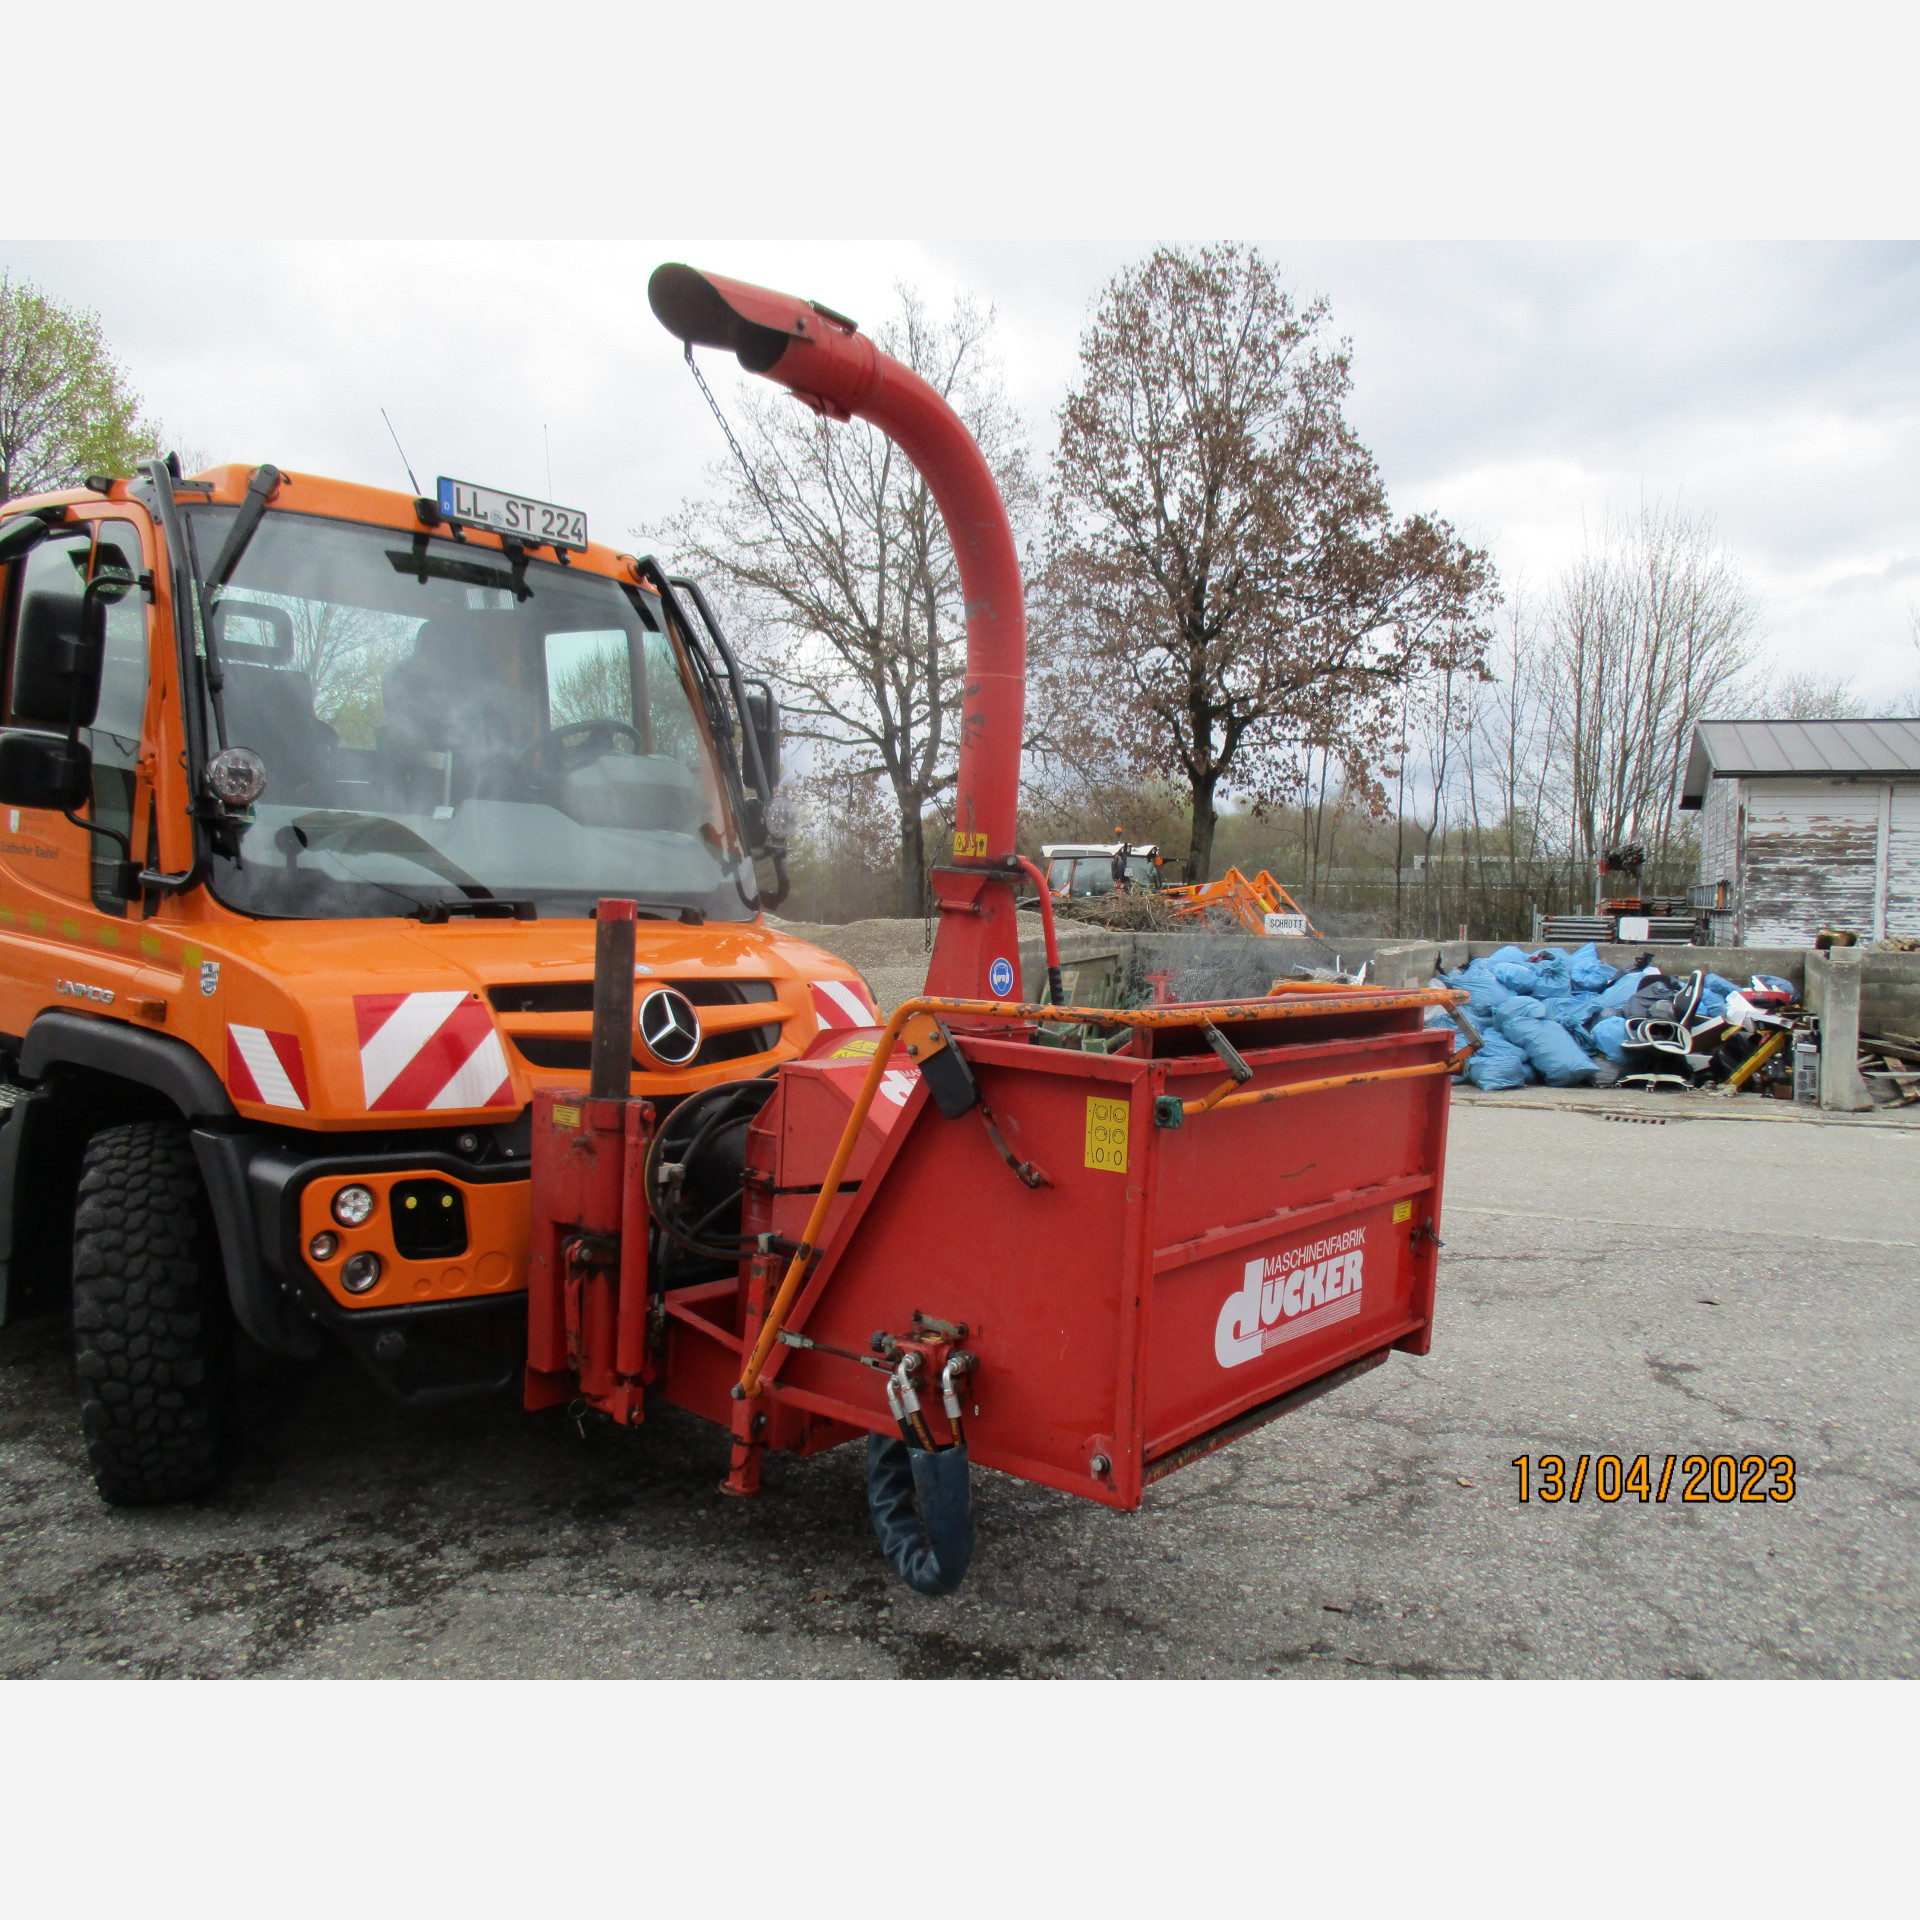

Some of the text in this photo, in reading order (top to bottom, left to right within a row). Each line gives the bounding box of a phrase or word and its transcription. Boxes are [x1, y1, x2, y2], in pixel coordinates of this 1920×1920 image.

[443, 501, 450, 511] D
[455, 487, 584, 543] LL ST 224
[1270, 918, 1304, 929] SCHROTT
[56, 979, 116, 1005] UNIMOG
[1264, 1226, 1367, 1278] MASCHINENFABRIK
